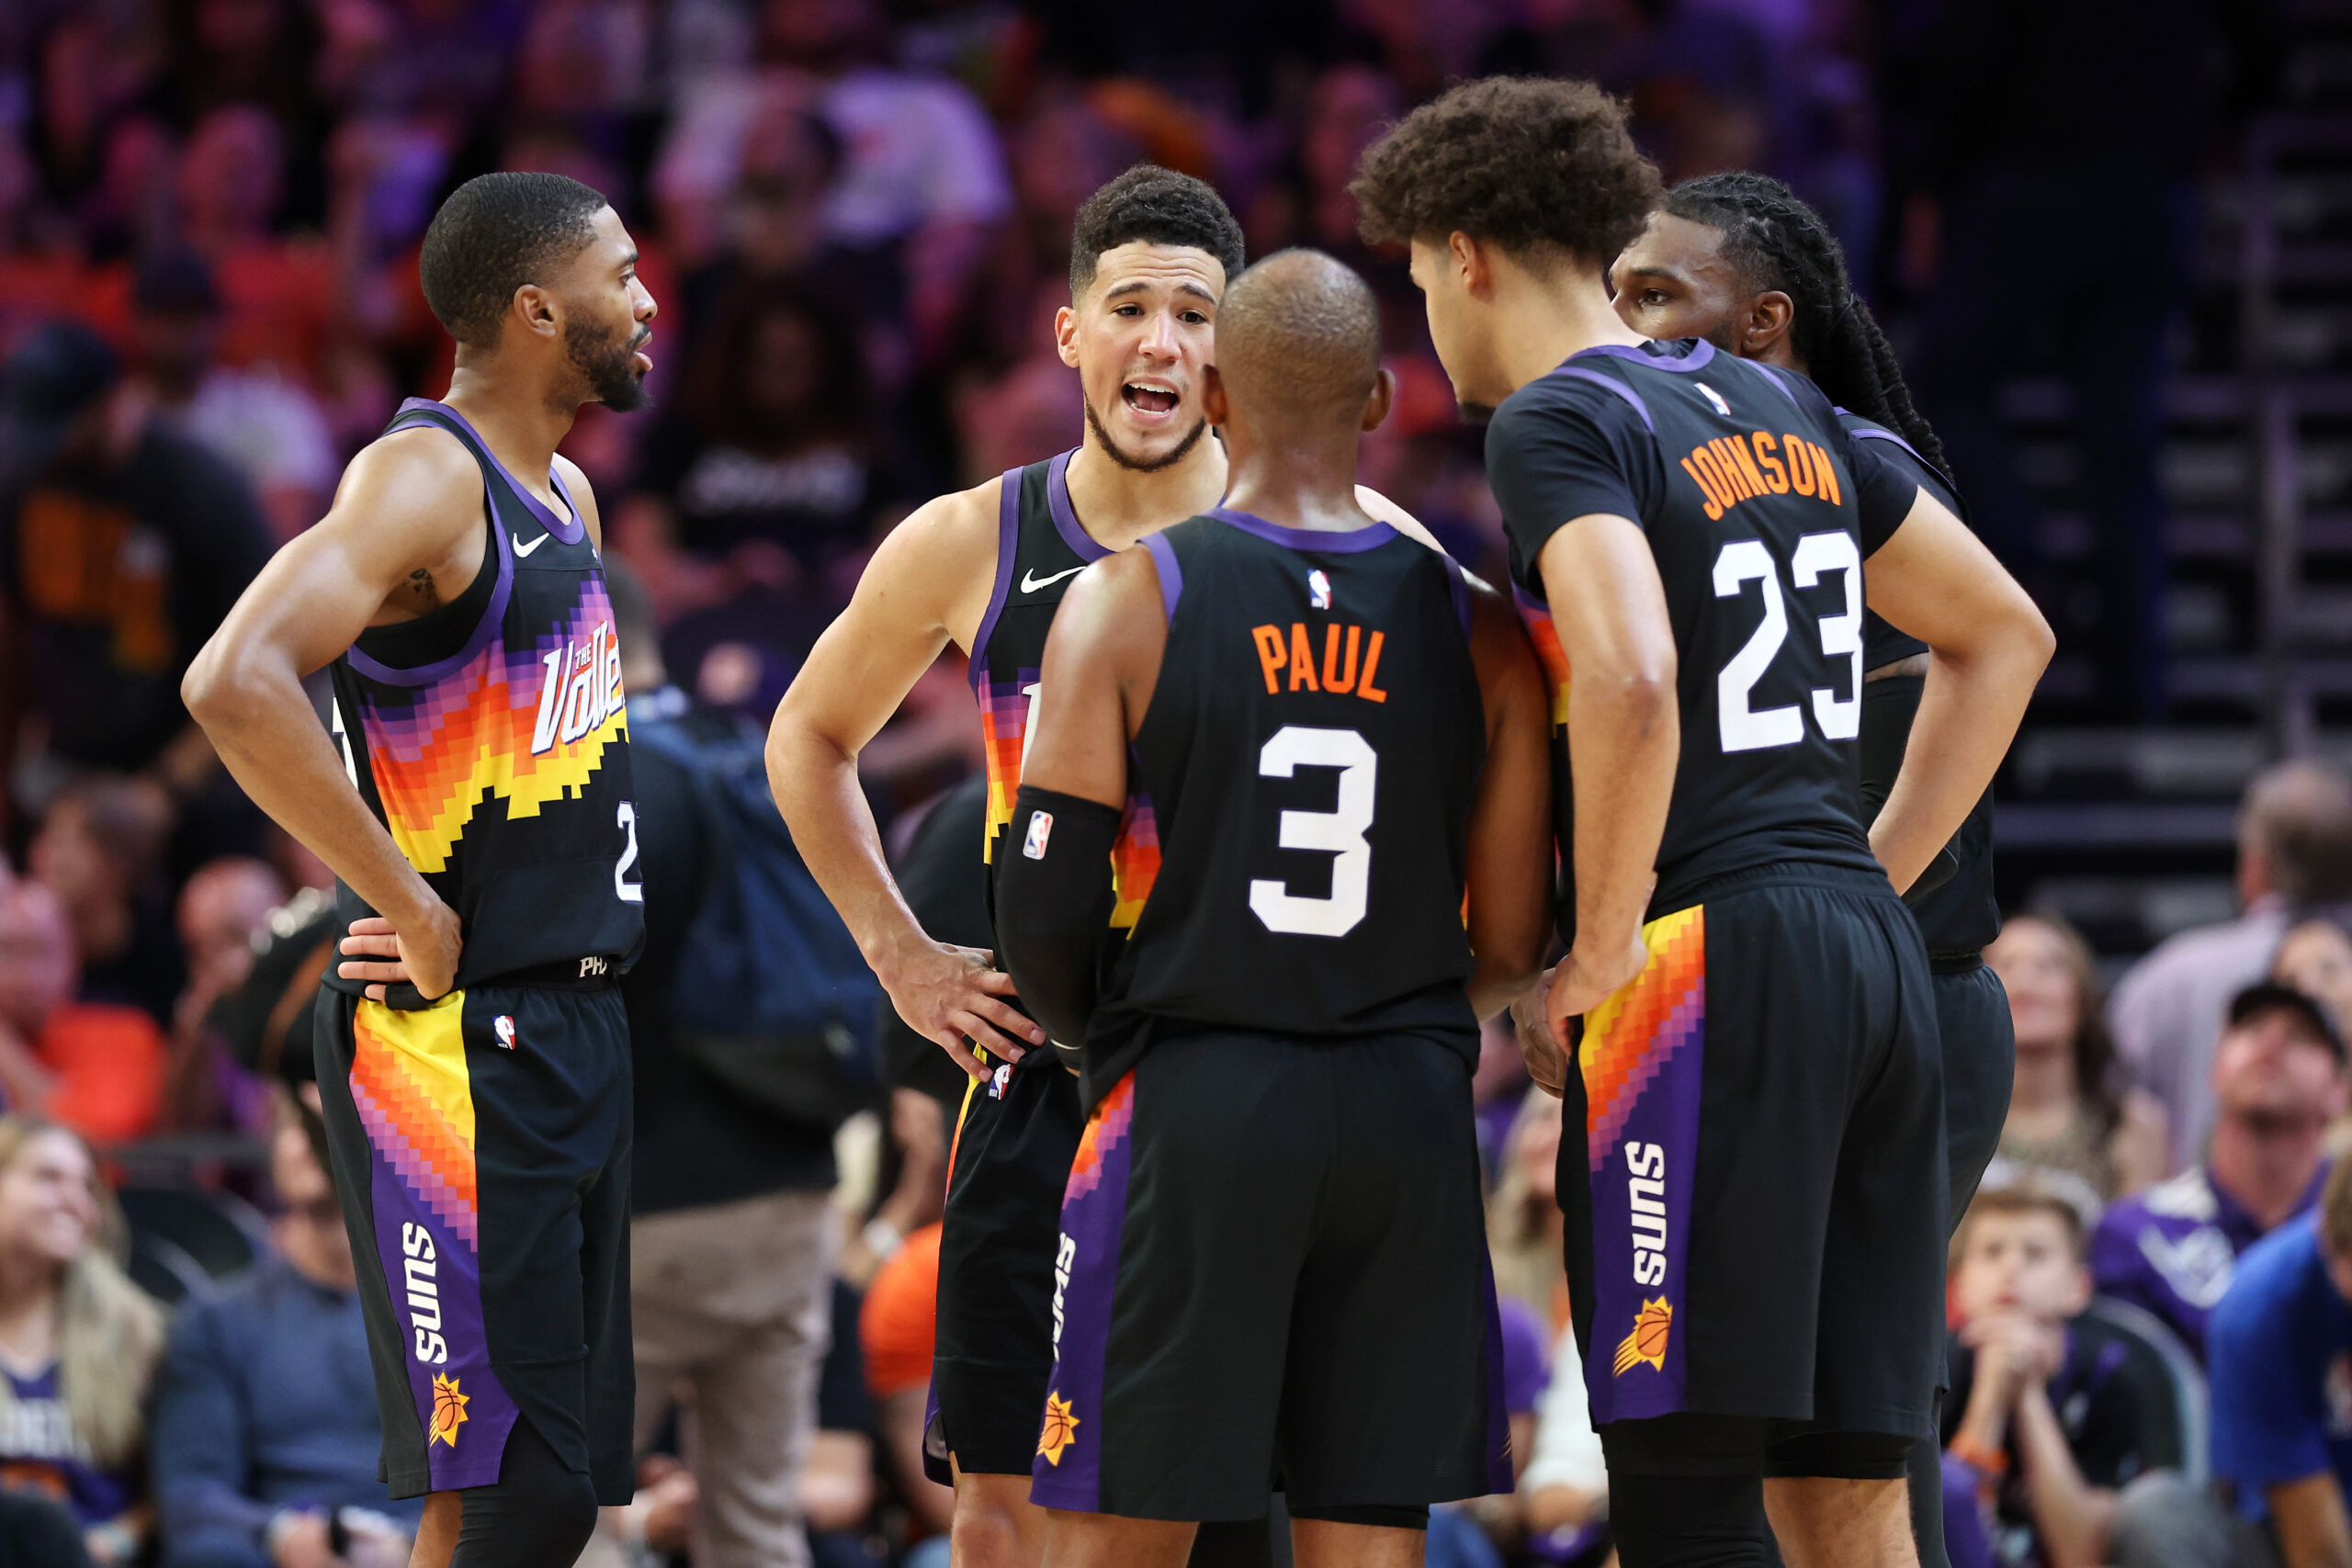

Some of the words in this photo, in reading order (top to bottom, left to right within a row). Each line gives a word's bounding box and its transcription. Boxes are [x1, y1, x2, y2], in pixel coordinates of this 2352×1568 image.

[1680, 431, 1841, 520] JOHNSON
[531, 620, 625, 756] Valle
[575, 642, 592, 671] THE
[1251, 623, 1387, 703] PAUL
[1712, 528, 1864, 753] 23
[1249, 723, 1377, 938] 3
[579, 955, 607, 978] PH
[1624, 1141, 1668, 1287] SUNS
[402, 1222, 448, 1364] SUNS
